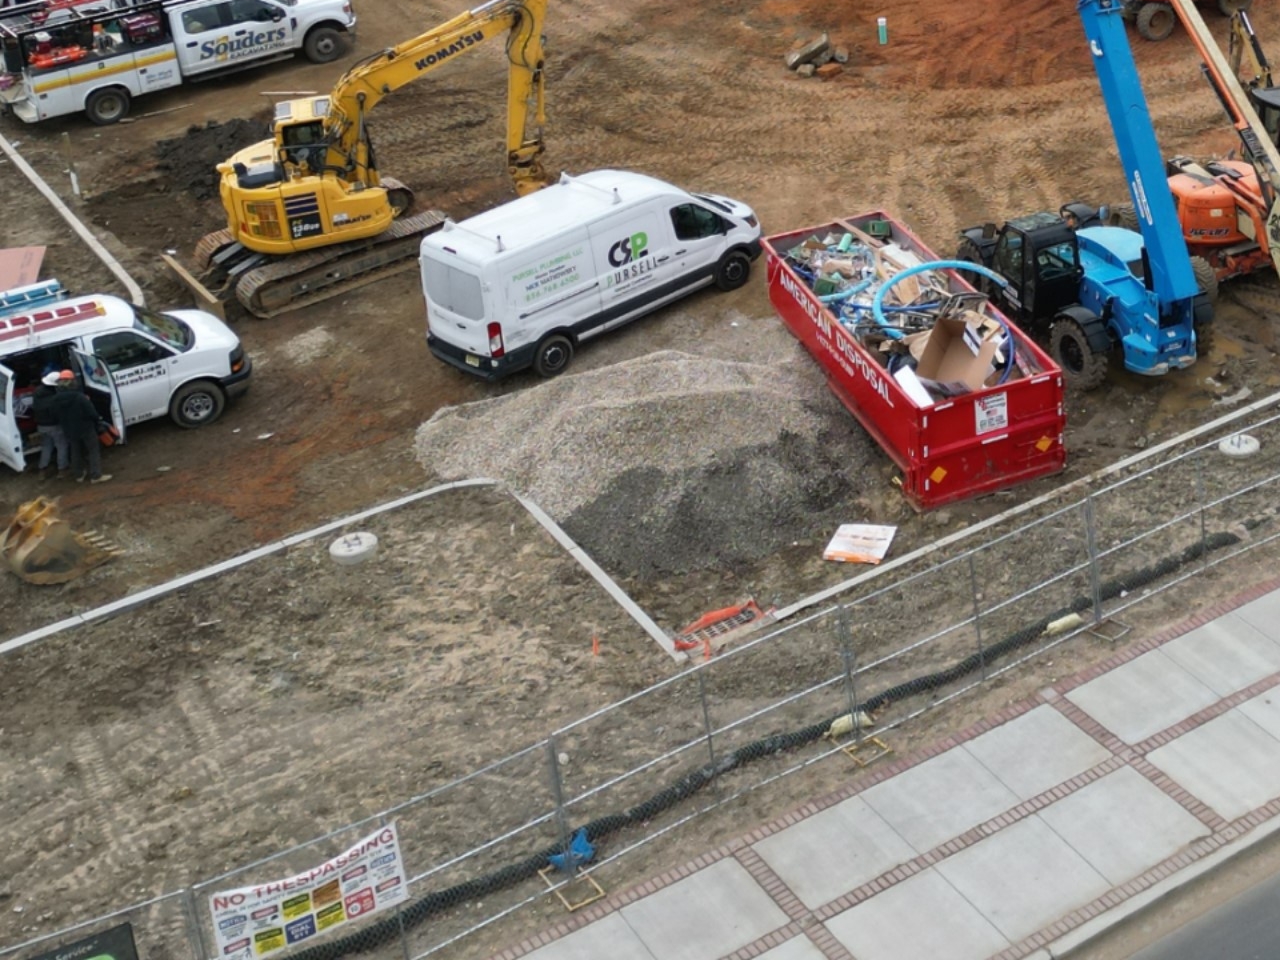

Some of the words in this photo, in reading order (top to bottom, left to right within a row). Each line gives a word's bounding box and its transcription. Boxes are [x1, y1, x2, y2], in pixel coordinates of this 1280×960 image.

[200, 28, 286, 60] Souders
[230, 42, 285, 60] EXCAVATING
[415, 30, 483, 70] KOMATSU
[607, 257, 657, 288] PURSELL
[780, 269, 832, 339] AMERICAN
[836, 330, 895, 408] DISPOSAL
[213, 893, 246, 911] NO
[252, 828, 394, 898] TRESPASSING
